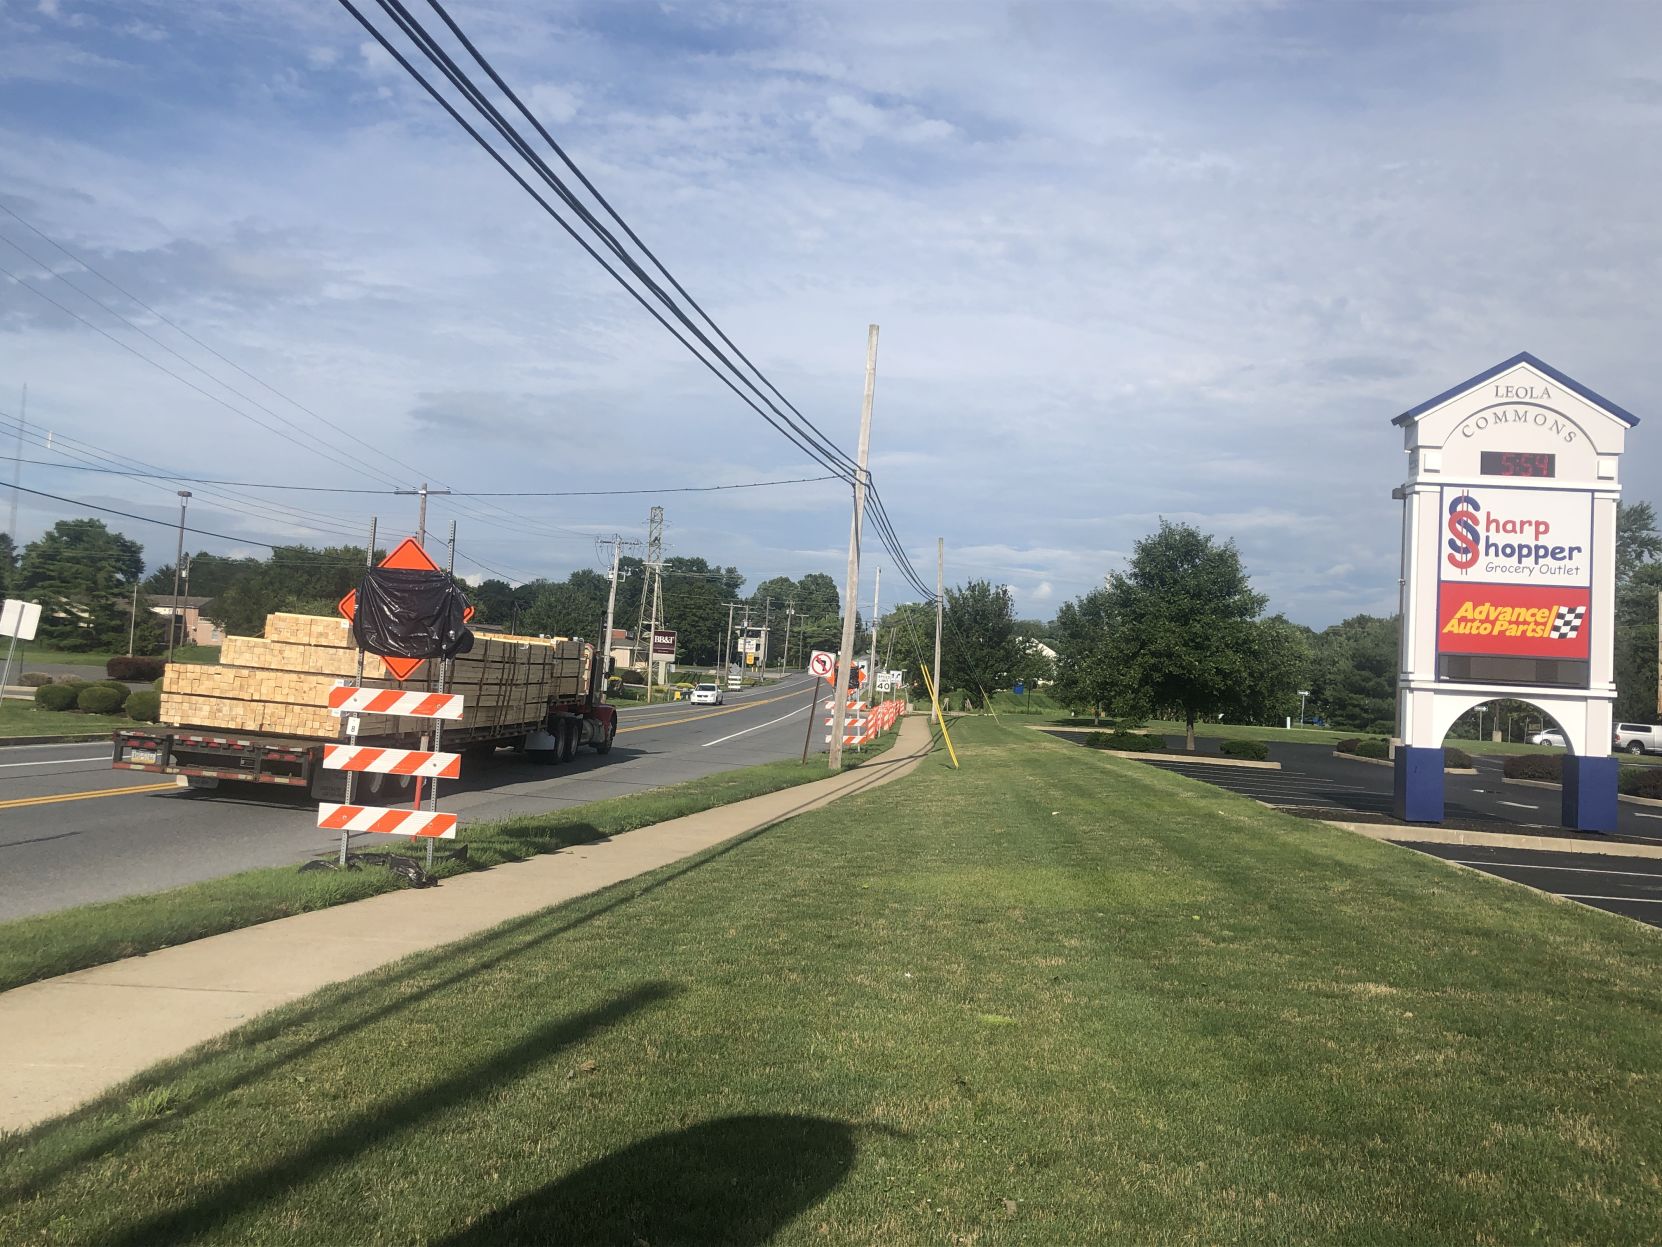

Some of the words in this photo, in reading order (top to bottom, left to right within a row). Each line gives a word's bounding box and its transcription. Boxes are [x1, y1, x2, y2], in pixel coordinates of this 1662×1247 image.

[1495, 385, 1551, 399] LEOLA
[1462, 409, 1576, 443] COMMONS
[1485, 562, 1535, 576] Grocery
[1539, 564, 1580, 576] Outlet
[1454, 601, 1549, 622] Advance
[1442, 619, 1491, 635] Auto
[1492, 621, 1545, 637] Parts
[654, 636, 674, 644] BB&T
[877, 682, 890, 690] 40
